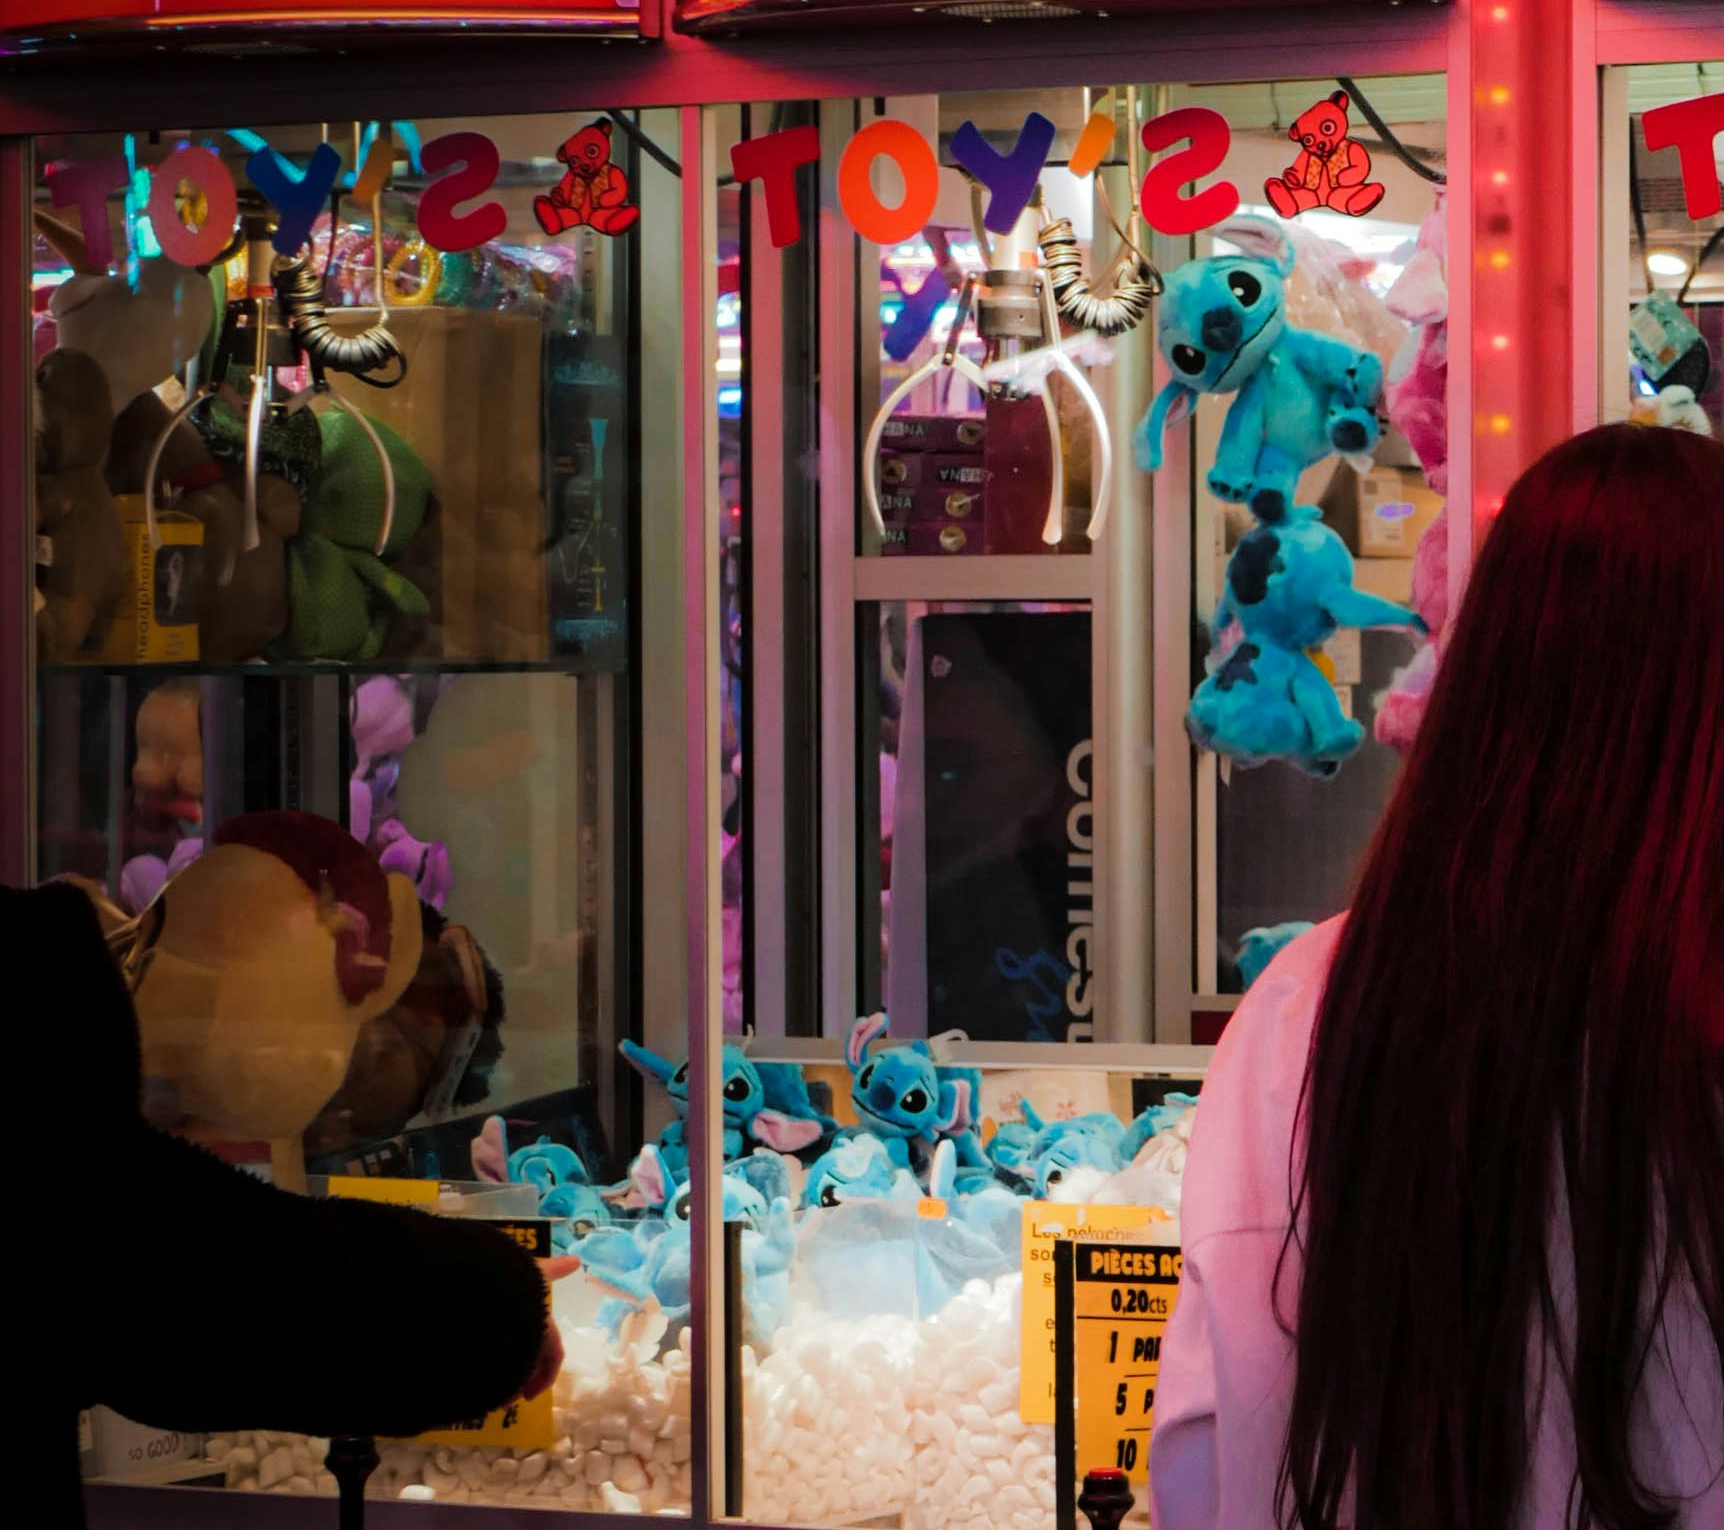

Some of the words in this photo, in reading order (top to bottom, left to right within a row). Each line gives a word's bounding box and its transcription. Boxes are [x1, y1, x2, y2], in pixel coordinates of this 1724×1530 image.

[1090, 1249, 1156, 1276] PIÈCES
[1109, 1331, 1119, 1363] 1
[1115, 1382, 1128, 1416] 5
[1117, 1438, 1138, 1471] 10
